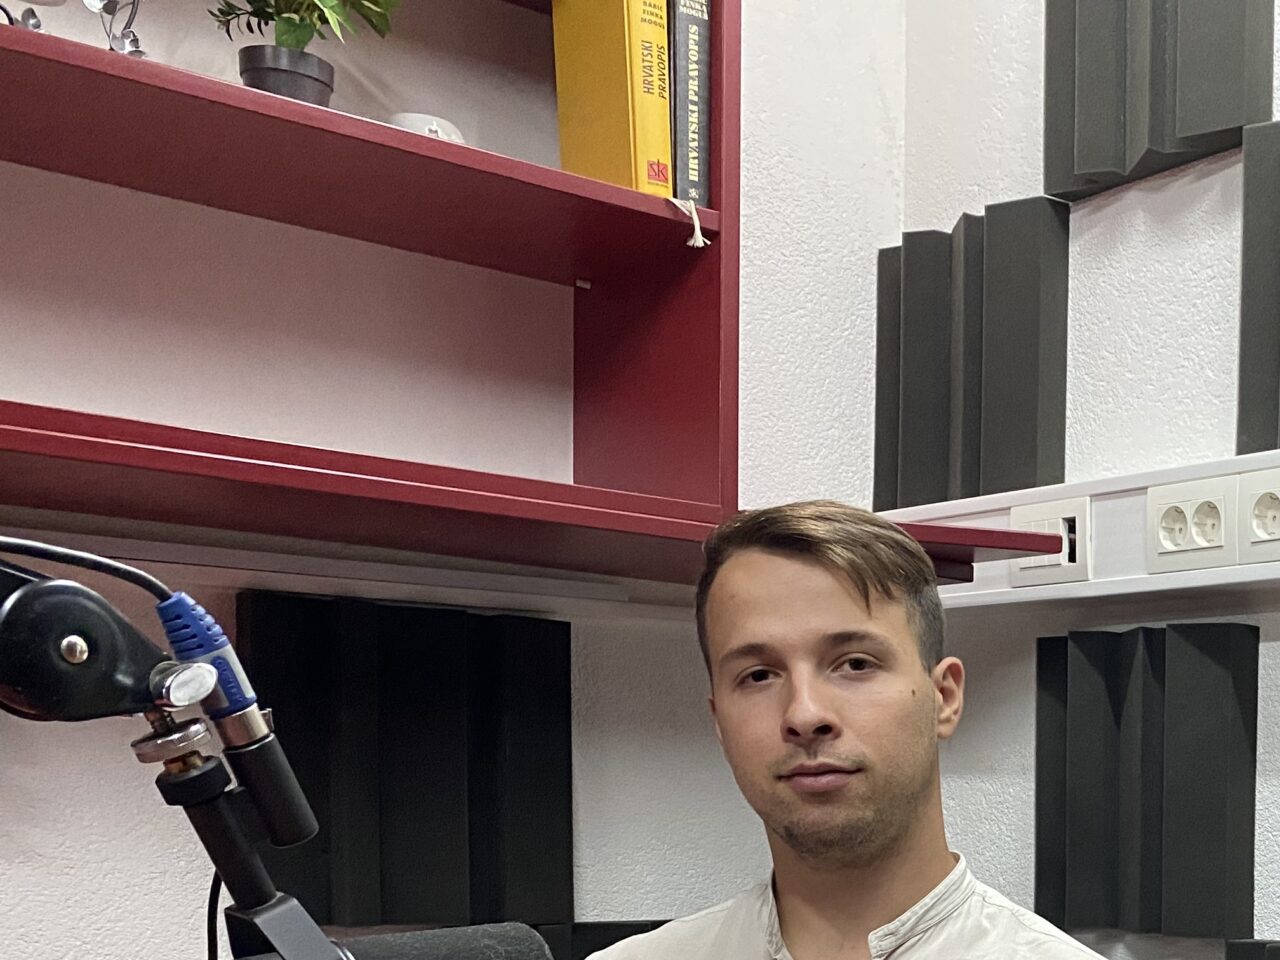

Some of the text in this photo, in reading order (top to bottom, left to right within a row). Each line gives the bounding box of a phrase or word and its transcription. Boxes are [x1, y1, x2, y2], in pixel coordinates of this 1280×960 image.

[642, 40, 655, 95] HRVATSKI
[657, 45, 667, 100] PRAVOPIS
[688, 24, 699, 182] HRVATSKI PRAVOPIS
